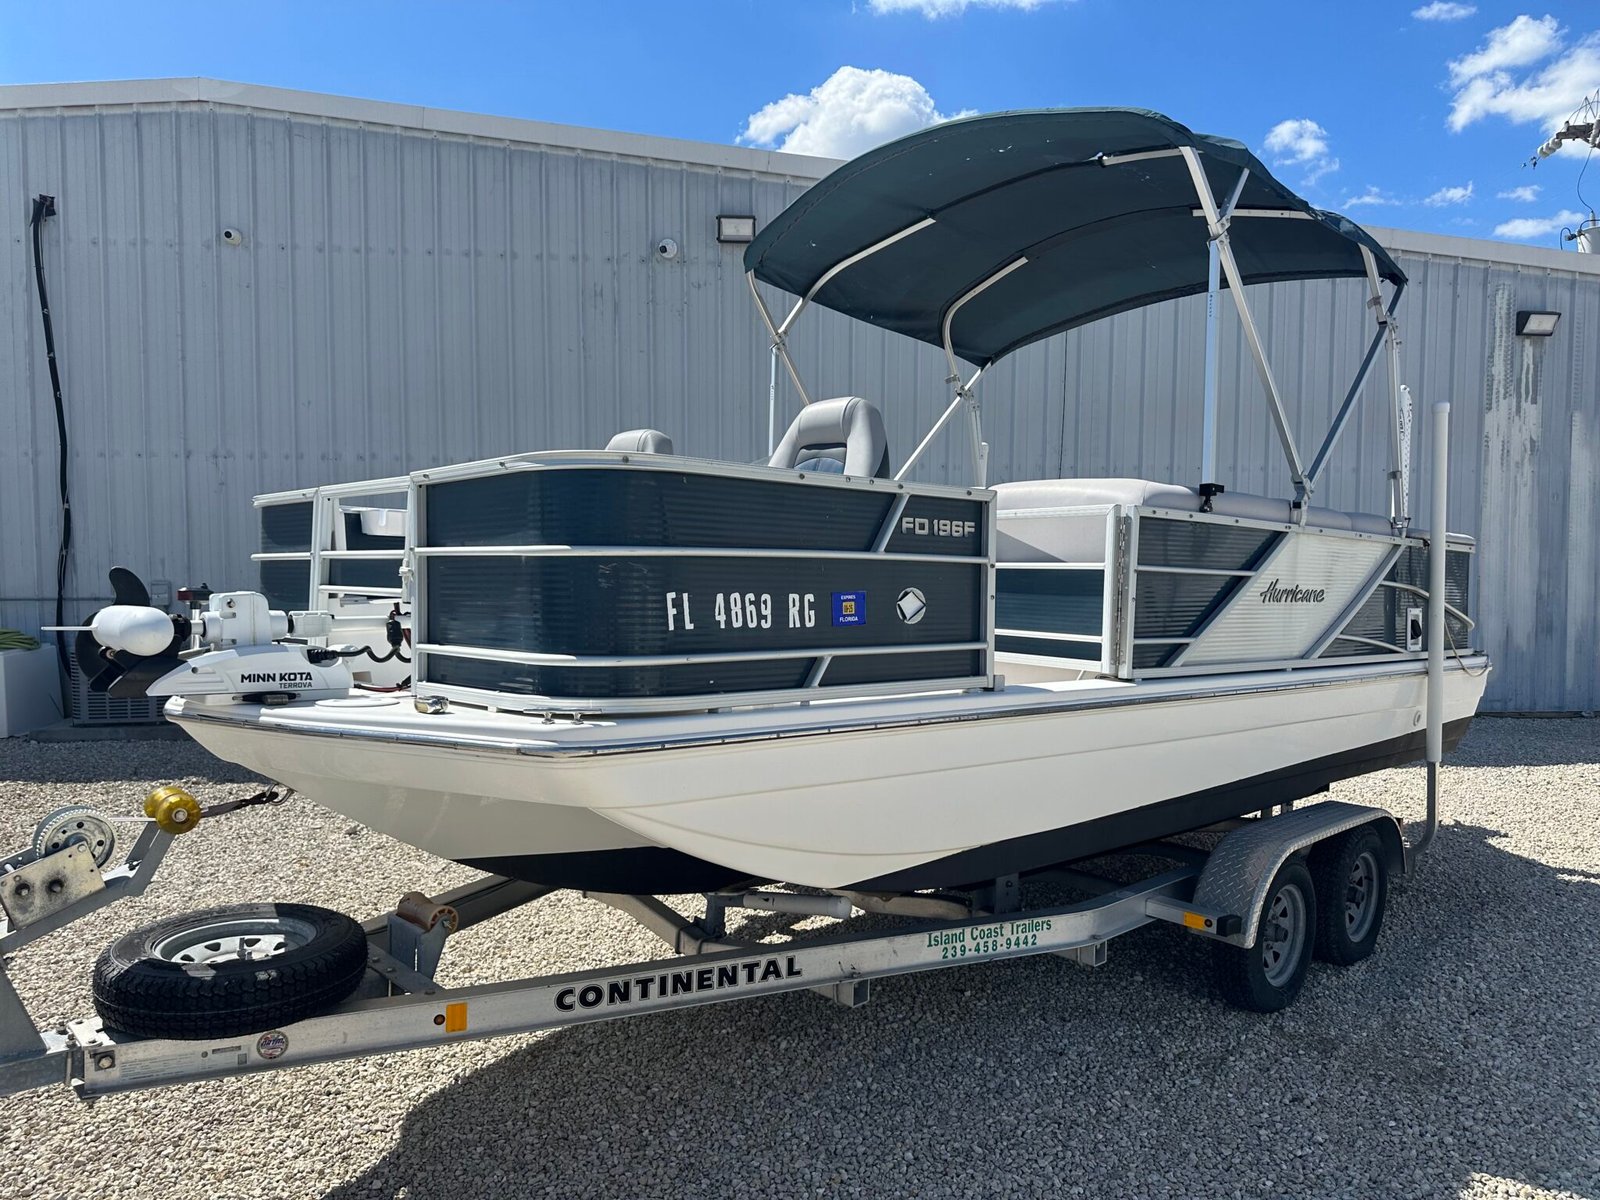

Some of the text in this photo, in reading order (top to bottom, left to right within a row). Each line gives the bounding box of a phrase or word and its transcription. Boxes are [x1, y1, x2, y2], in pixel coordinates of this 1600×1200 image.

[902, 517, 975, 537] FD 196F
[1260, 578, 1325, 603] Hurricane
[666, 591, 815, 631] FL 4869 RG
[240, 671, 313, 683] MINN KOTA
[279, 681, 313, 689] TERROVA
[926, 919, 1052, 948] Island Coast Trailers
[942, 933, 1037, 960] 239-458-9442
[554, 954, 803, 1013] CONTINENTAL
